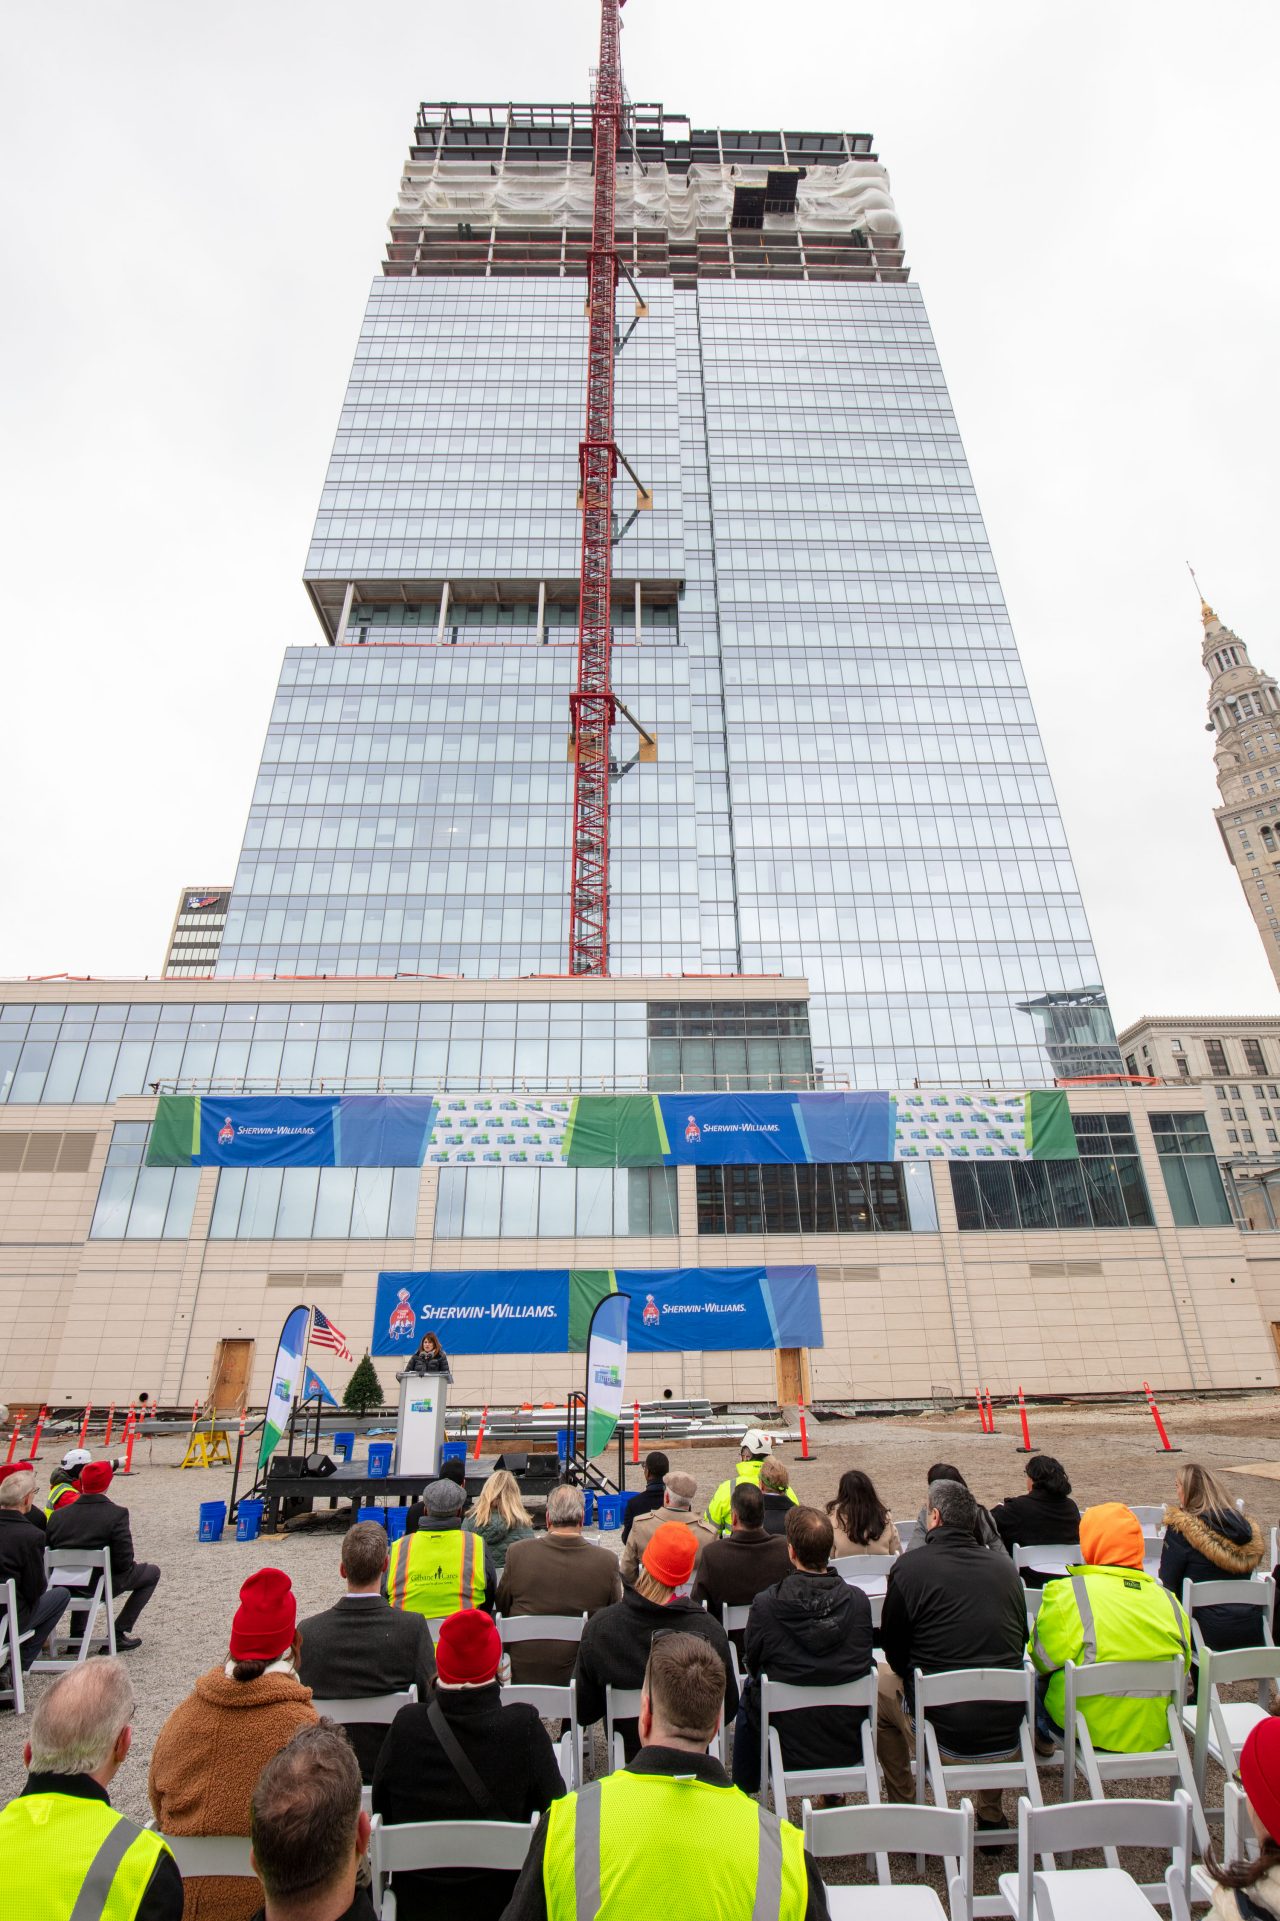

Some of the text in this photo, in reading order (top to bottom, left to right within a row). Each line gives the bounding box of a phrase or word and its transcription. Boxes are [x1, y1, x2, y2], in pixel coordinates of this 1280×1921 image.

[237, 1126, 315, 1135] SHERWIN-WILLIAMS
[703, 1123, 779, 1132] SHERWIN-WILLIAMS
[420, 1303, 556, 1320] SHERWIN-WILLIAMS
[662, 1302, 745, 1314] SHERWIN-WILLIAMS
